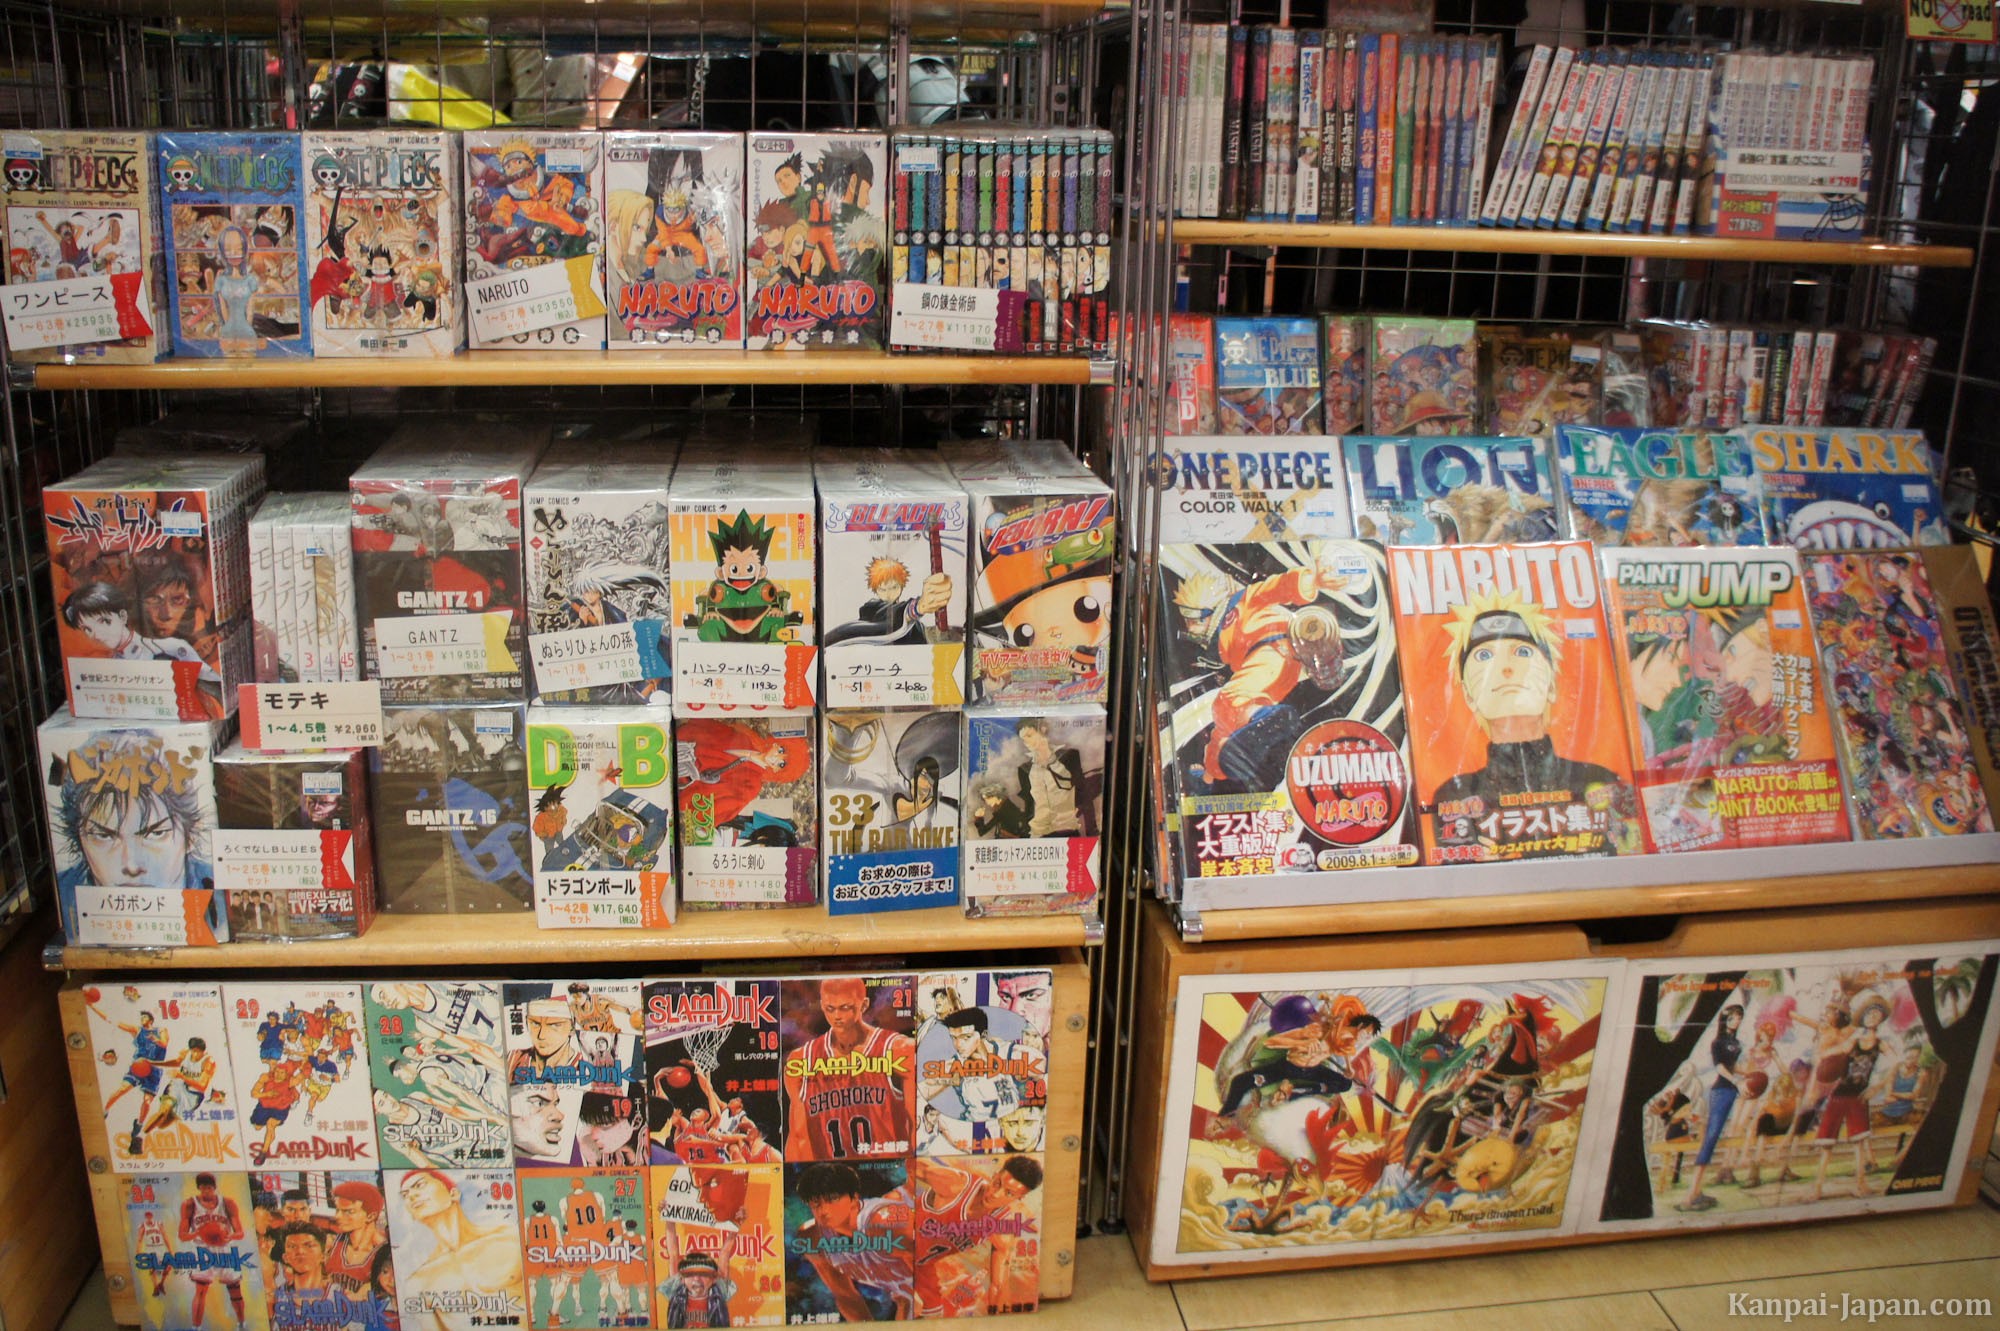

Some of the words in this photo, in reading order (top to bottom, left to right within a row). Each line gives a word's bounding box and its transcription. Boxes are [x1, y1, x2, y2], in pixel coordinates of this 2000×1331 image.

[14, 286, 109, 310] ワンピース
[477, 278, 530, 304] NARUTO
[617, 281, 738, 319] NARUTO
[757, 281, 876, 319] NARUTO
[921, 292, 977, 312] 鋼の錬金術師
[1264, 367, 1320, 388] BLUE
[1176, 361, 1198, 421] RED
[1564, 429, 1749, 482] EAGLE
[1752, 429, 1929, 475] SHARK
[1239, 450, 1334, 490] PIECE
[1358, 443, 1538, 500] LION
[548, 497, 570, 505] COMICS
[674, 504, 690, 513] JUMP
[694, 504, 717, 513] COMICS
[1179, 501, 1238, 514] COLOR
[1241, 501, 1285, 513] WALK
[1289, 501, 1298, 513] 1
[847, 502, 944, 524] BLEACH
[986, 497, 1108, 552] REBORN!
[1393, 545, 1597, 616] NARUTO
[1618, 562, 1680, 586] PAINT
[1664, 561, 1793, 608] JUMP
[397, 591, 468, 609] GANTZ
[408, 629, 459, 645] GANTZ
[541, 631, 634, 660] ぬらりひょんの孫
[263, 653, 270, 669] 1
[305, 653, 314, 667] 3
[325, 653, 334, 667] 4
[690, 662, 782, 676] ハンター×ハンター
[848, 663, 903, 676] ブリーチ
[80, 673, 165, 685] 新世紀エヴァンゲリオン
[471, 677, 522, 689] 二宮和也
[264, 691, 329, 710] モテキ
[1785, 653, 1799, 760] カラーテクニック
[334, 723, 377, 735] ¥2,960
[311, 735, 327, 743] set
[560, 741, 594, 749] DRAGON
[526, 723, 578, 790] D
[617, 722, 669, 789] B
[561, 762, 591, 771] 鳥山明
[1290, 751, 1399, 788] UZUMAKI
[828, 793, 875, 826] 33
[1314, 798, 1388, 825] NARUTO
[1708, 797, 1751, 818] PAINT
[405, 809, 475, 826] GANTZ
[1195, 811, 1287, 836] イラスト集
[1479, 804, 1607, 839] イラスト集!!
[223, 844, 317, 855] ろくでなしBLUES
[1197, 834, 1280, 858] 大重版!!
[712, 853, 766, 870] るろうに剣心
[1325, 854, 1376, 869] 2009.8.1
[860, 863, 933, 882] お求めの際は
[547, 878, 636, 896] ドラゴンボール
[834, 878, 953, 900] お近くのスタッフまで!
[99, 894, 166, 912] バガボンド
[289, 897, 353, 914] TVドラマ化!
[593, 903, 638, 915] ¥17,640
[591, 985, 606, 994] JUMP
[607, 985, 629, 993] COMICS
[865, 978, 882, 987] JUMP
[883, 978, 903, 986] COMICS
[892, 988, 912, 1008] 21
[158, 999, 180, 1020] 16
[236, 998, 260, 1020] 29
[379, 1014, 403, 1036] 28
[758, 1031, 779, 1050] 18
[725, 1079, 779, 1093] 井上雄彦
[1024, 1079, 1047, 1099] 20
[611, 1099, 632, 1118] 19
[808, 1087, 886, 1117] SHOHOKU
[182, 1109, 236, 1121] 井上雄彦
[316, 1119, 369, 1132] 井上雄彦
[826, 1115, 873, 1159] 10
[453, 1148, 505, 1160] 井上雄彦
[856, 1141, 909, 1154] 井上雄彦
[465, 1173, 481, 1181] JUMP
[482, 1173, 504, 1181] COMICS
[669, 1178, 693, 1195] GO!
[489, 1181, 514, 1201] 30
[614, 1177, 638, 1197] 27
[575, 1205, 597, 1226] 10
[888, 1205, 909, 1222] 22
[533, 1222, 549, 1240] 11
[759, 1275, 782, 1293] 26
[470, 1314, 521, 1327] 井上雄彦
[790, 1312, 841, 1326] 井上雄彦
